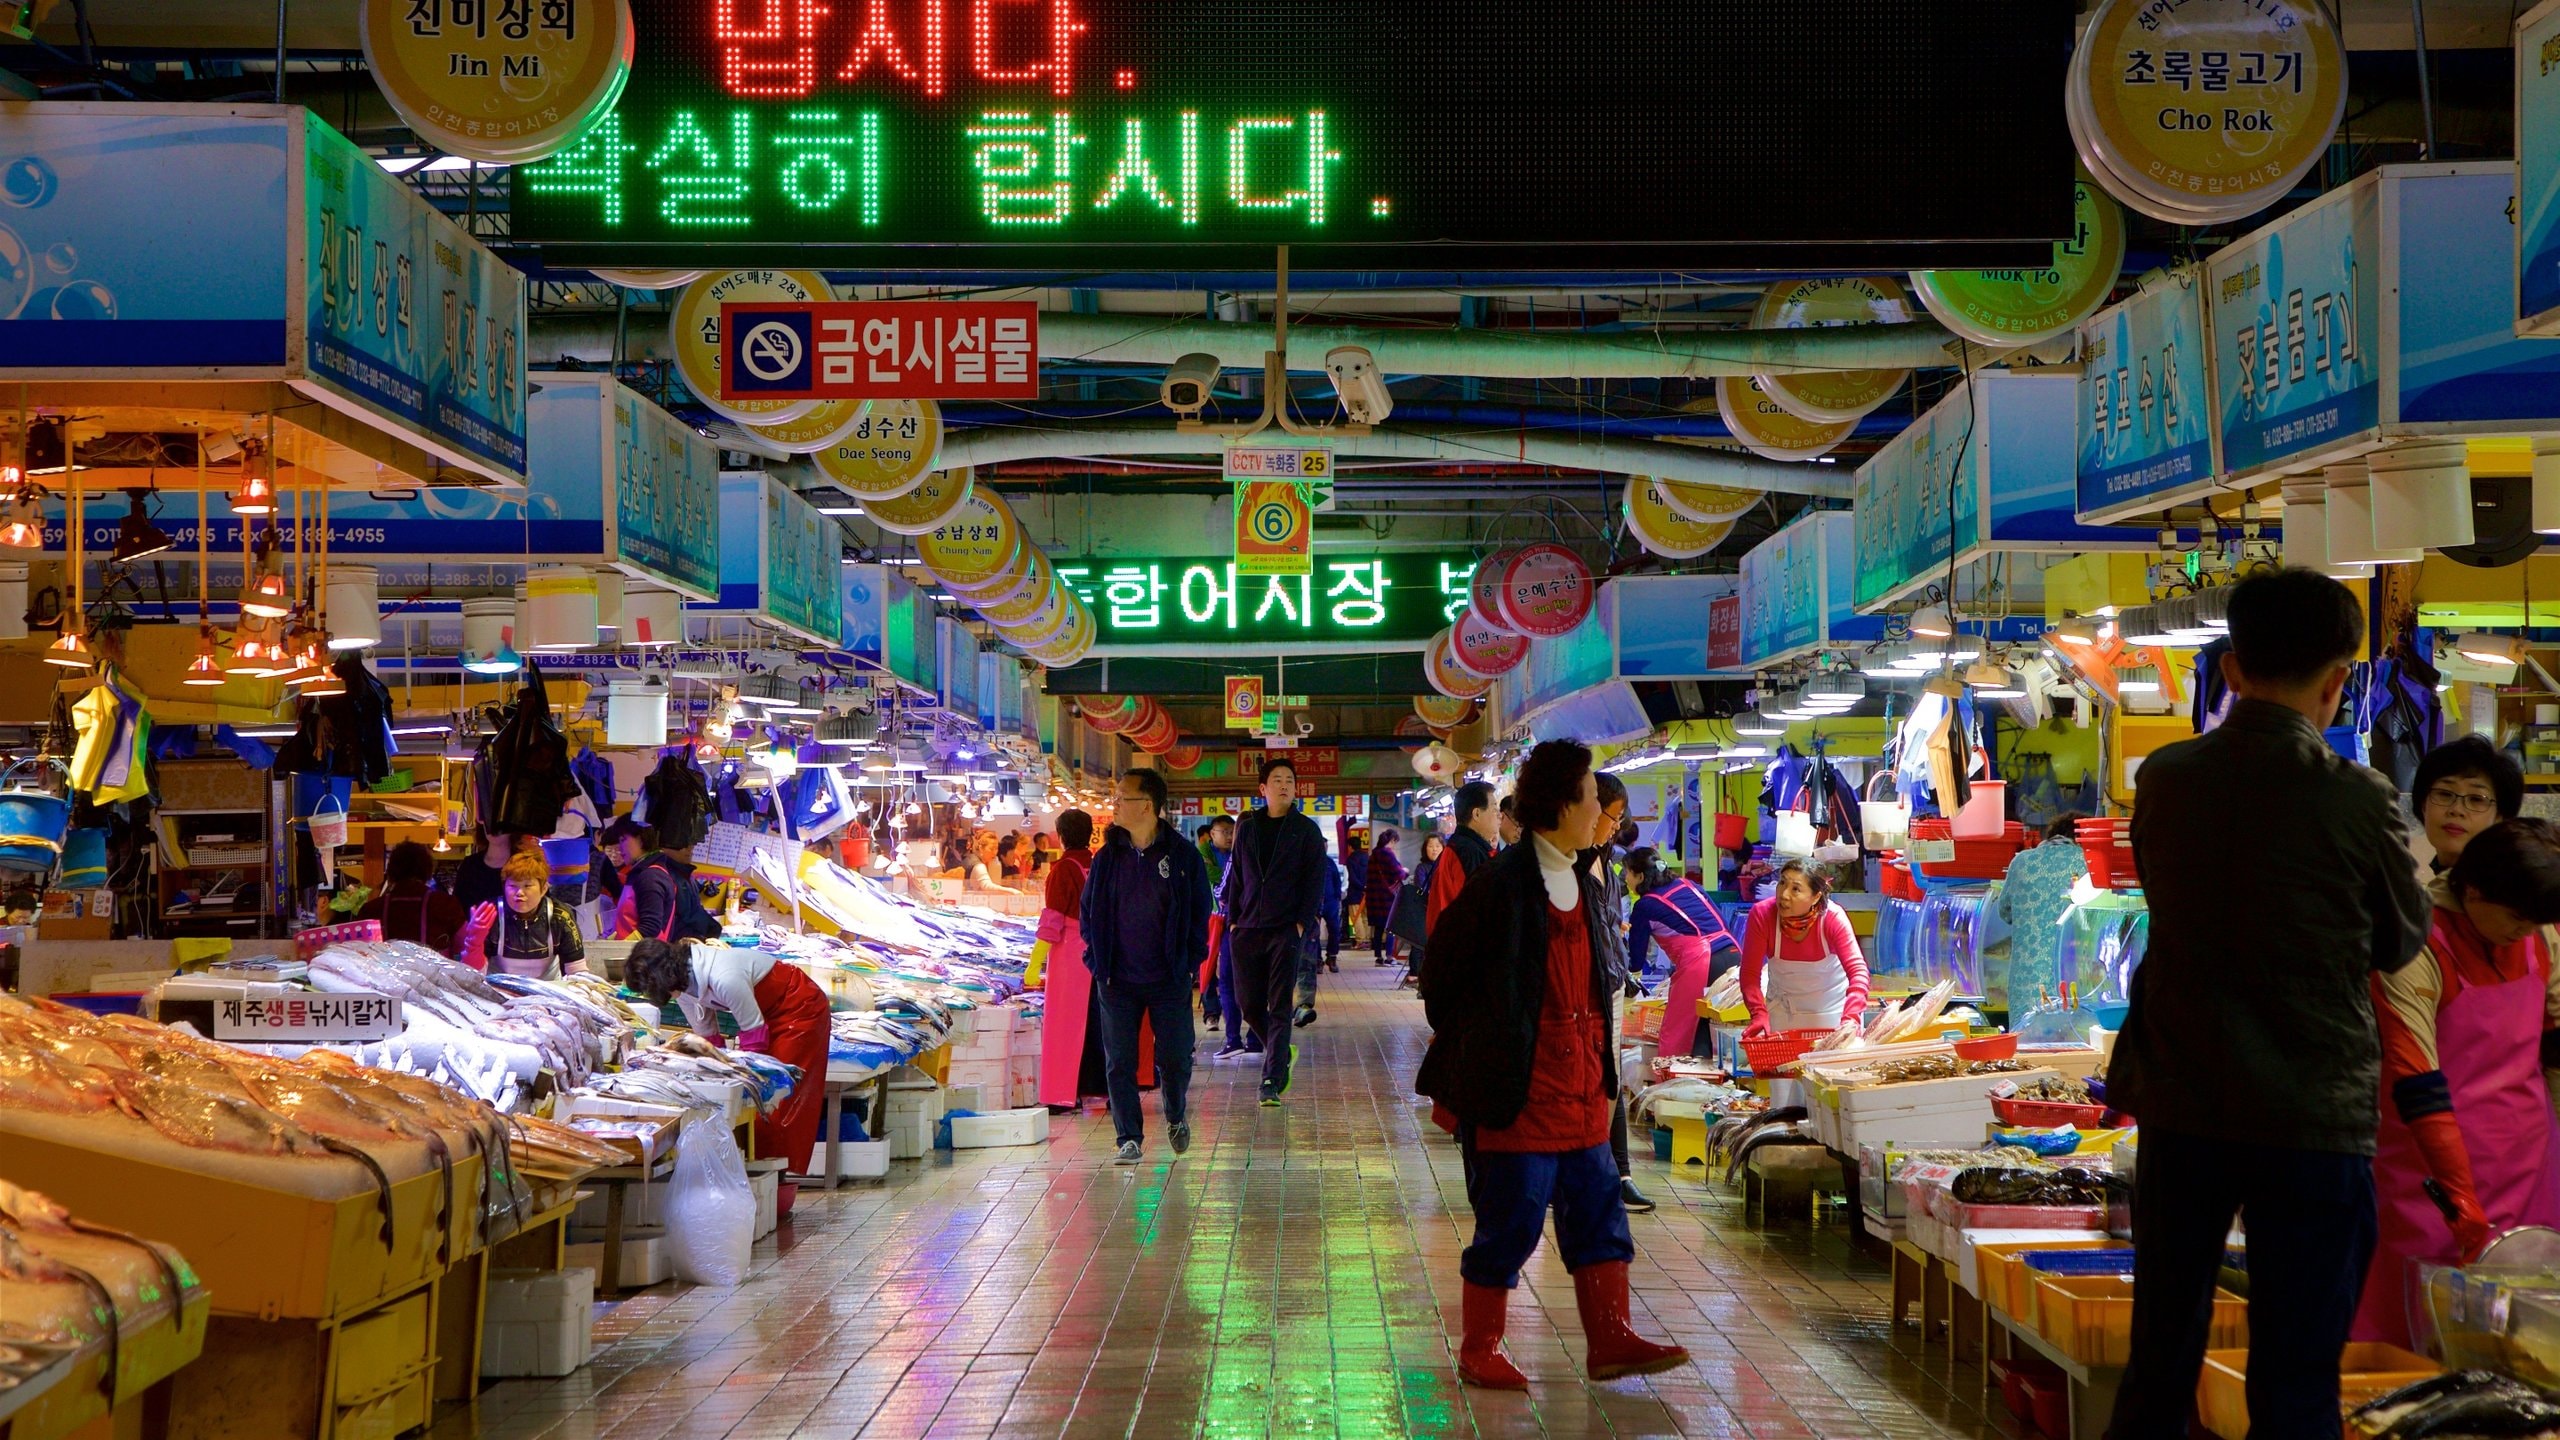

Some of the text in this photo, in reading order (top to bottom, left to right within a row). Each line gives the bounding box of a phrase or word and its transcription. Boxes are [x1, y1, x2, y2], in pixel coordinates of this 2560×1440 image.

[405, 0, 576, 41] 진미상회
[2243, 0, 2297, 34] 11호
[448, 53, 540, 78] Jin Mi
[2124, 50, 2302, 94] 초록물고기
[426, 104, 560, 138] 인천종합어시장
[2158, 108, 2274, 131] Cho Rok
[965, 111, 1391, 225] 합시다.
[2148, 160, 2283, 193] 인천종합어시장
[319, 206, 413, 354] 진미상회
[709, 270, 808, 302] 선어도매부 28호
[1981, 270, 2061, 285] Mok Po
[1965, 302, 2070, 332] 인천종합어시장
[817, 316, 1032, 385] 금연시설물
[1797, 388, 1880, 409] 인천종합어시장
[2095, 342, 2178, 449] 목포수산
[853, 416, 918, 440] 성수산
[1759, 430, 1835, 449] 인천종합어시장
[838, 446, 912, 462] Dae Seong
[1232, 454, 1325, 473] CCTV 녹화중 25
[840, 473, 910, 492] 인천종합어시장
[926, 486, 940, 497] Su
[1264, 508, 1283, 536] 6
[938, 545, 993, 556] Chung Nam
[1057, 560, 1392, 628] 합어시장
[1533, 598, 1573, 616] Eun Hye
[1710, 605, 1740, 636] 화장실
[2018, 623, 2041, 635] Tel.
[1464, 631, 1514, 648] 연안수
[550, 655, 641, 665] 032-882-713
[1239, 695, 1249, 709] 5
